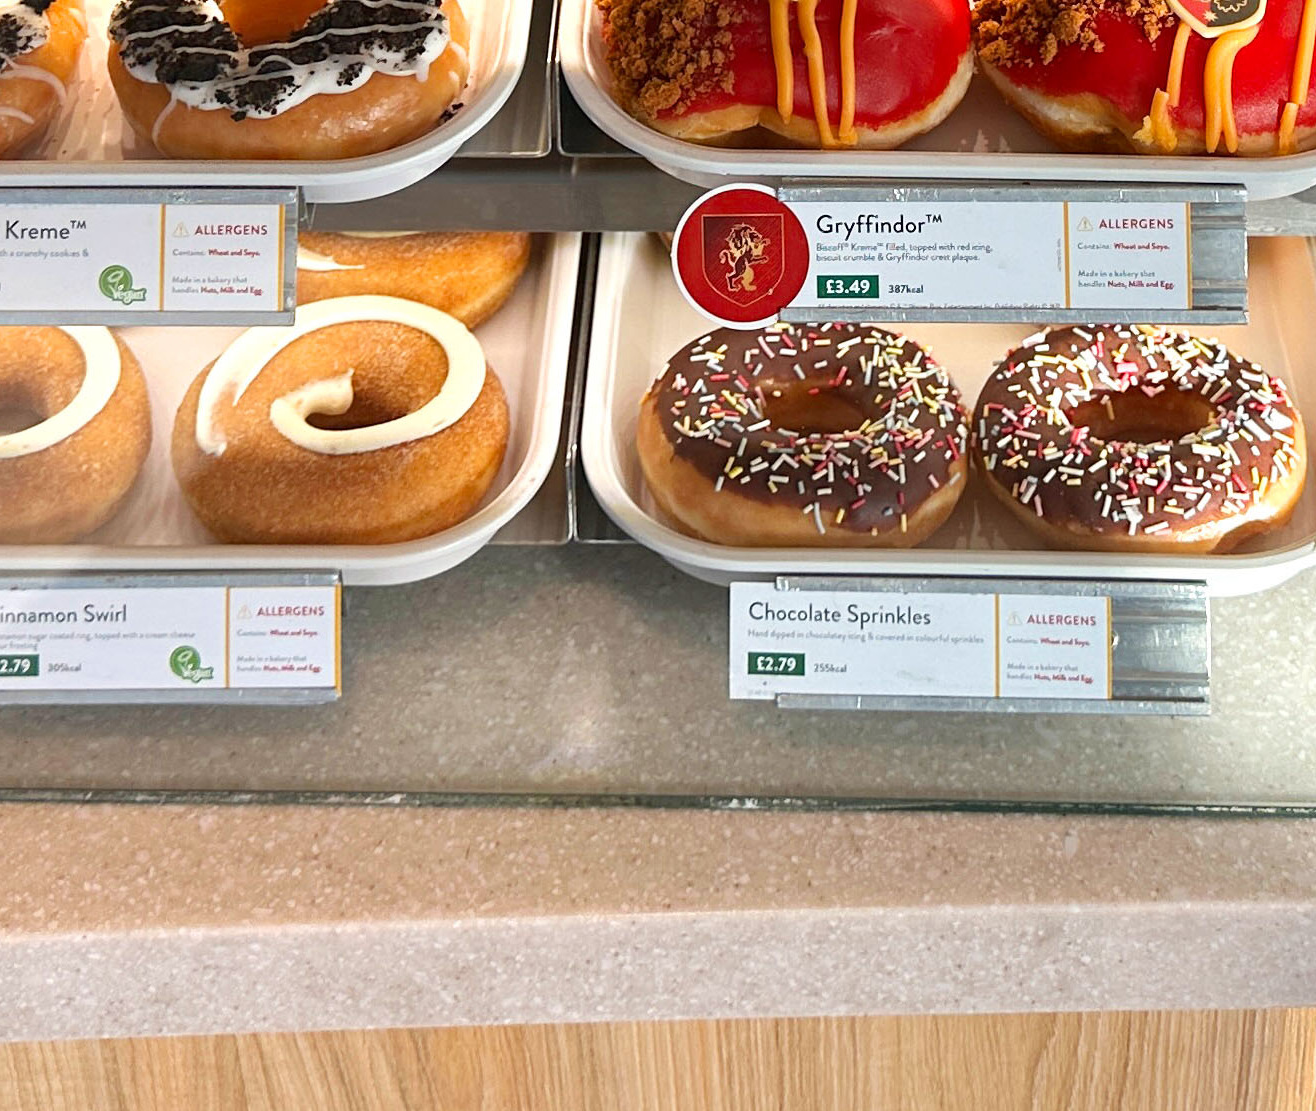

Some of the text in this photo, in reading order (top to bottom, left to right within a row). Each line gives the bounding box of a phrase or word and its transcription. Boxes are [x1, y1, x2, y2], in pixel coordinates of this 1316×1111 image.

[1099, 218, 1174, 229] ALLERGENS
[194, 224, 268, 236] ALLERGENS
[825, 279, 871, 295] £3.49
[888, 284, 924, 294] 387kcal
[83, 604, 127, 623] Swirl
[257, 605, 325, 617] ALLERGENS
[749, 601, 932, 630] Chocolate Sprinkles
[1027, 614, 1097, 626] ALLERGENS
[756, 656, 797, 672] £2.79
